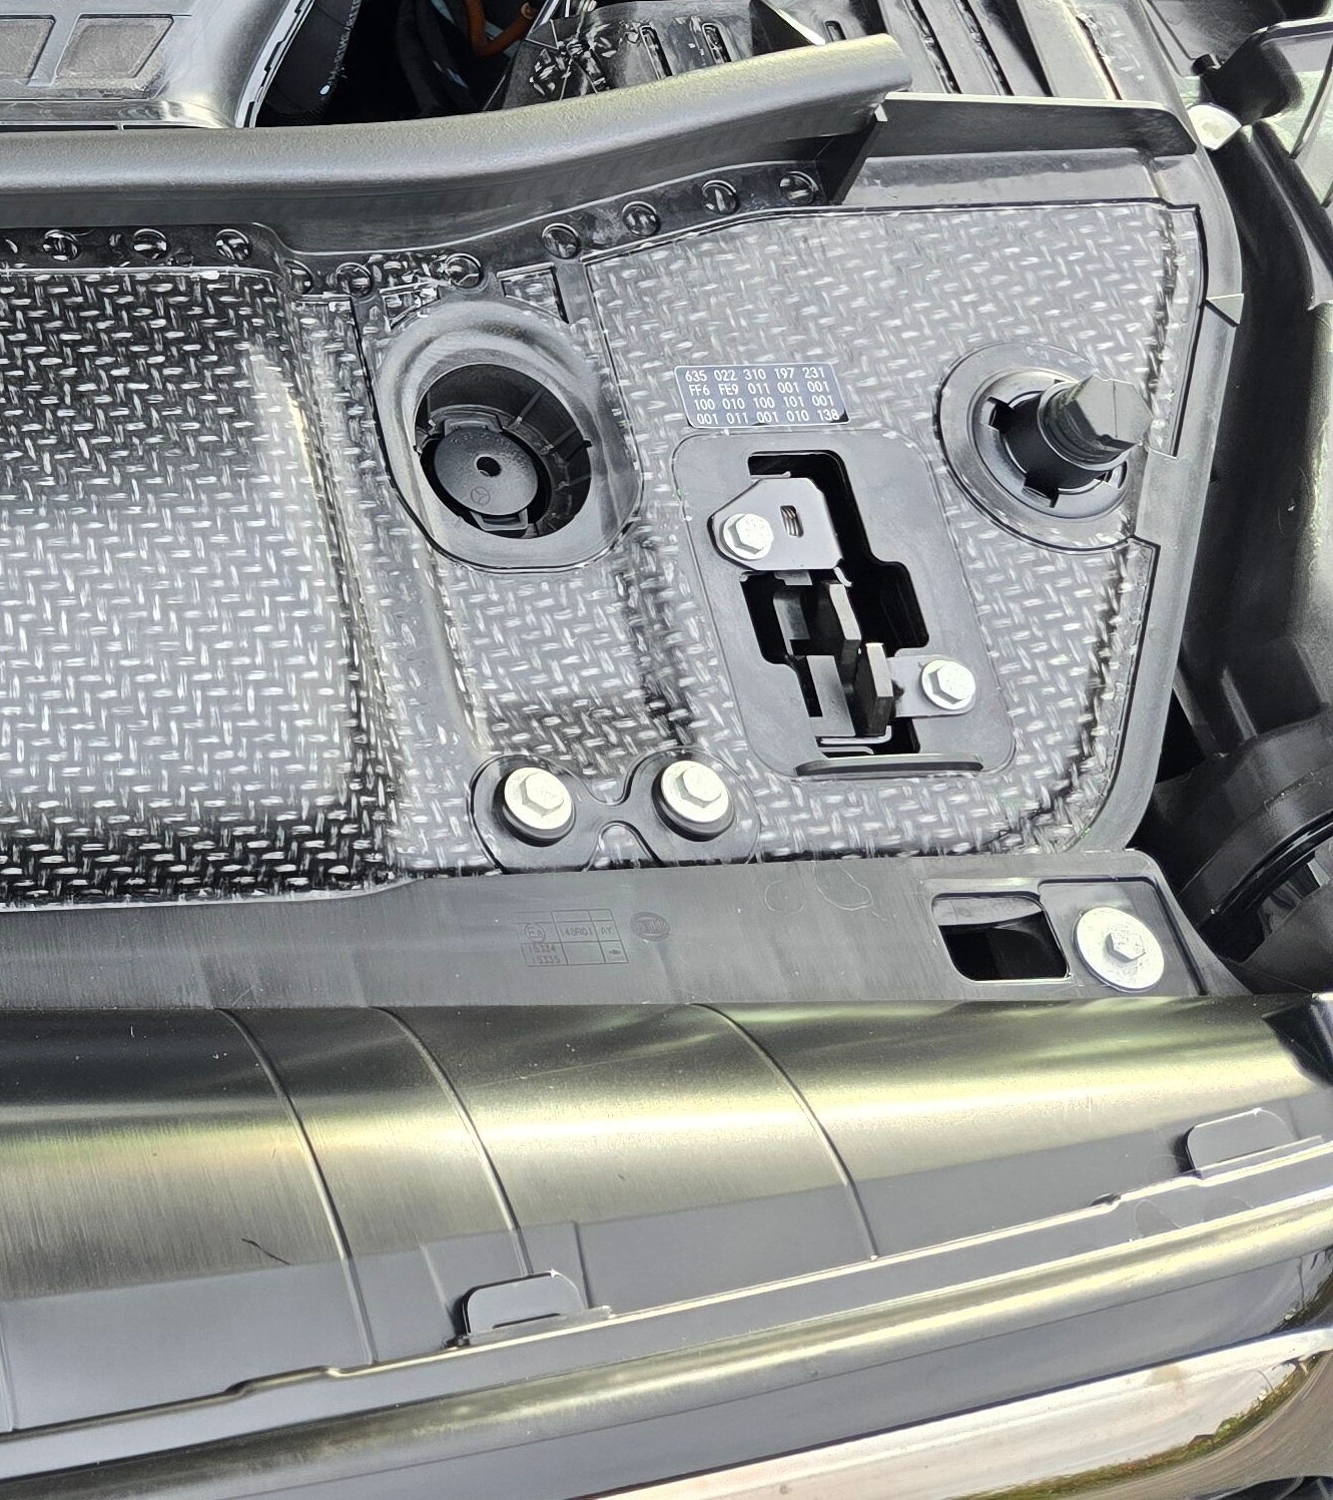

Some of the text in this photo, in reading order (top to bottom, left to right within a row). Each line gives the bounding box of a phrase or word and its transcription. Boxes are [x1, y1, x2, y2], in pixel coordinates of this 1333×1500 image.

[685, 367, 825, 382] 635 022 310 197 231
[689, 381, 829, 396] FF6 FE9 011 001 001
[694, 395, 834, 410] 100 010 100 101 001
[697, 413, 718, 425] 001
[726, 412, 748, 424] 011
[757, 411, 778, 422] 001
[786, 410, 809, 421] 010
